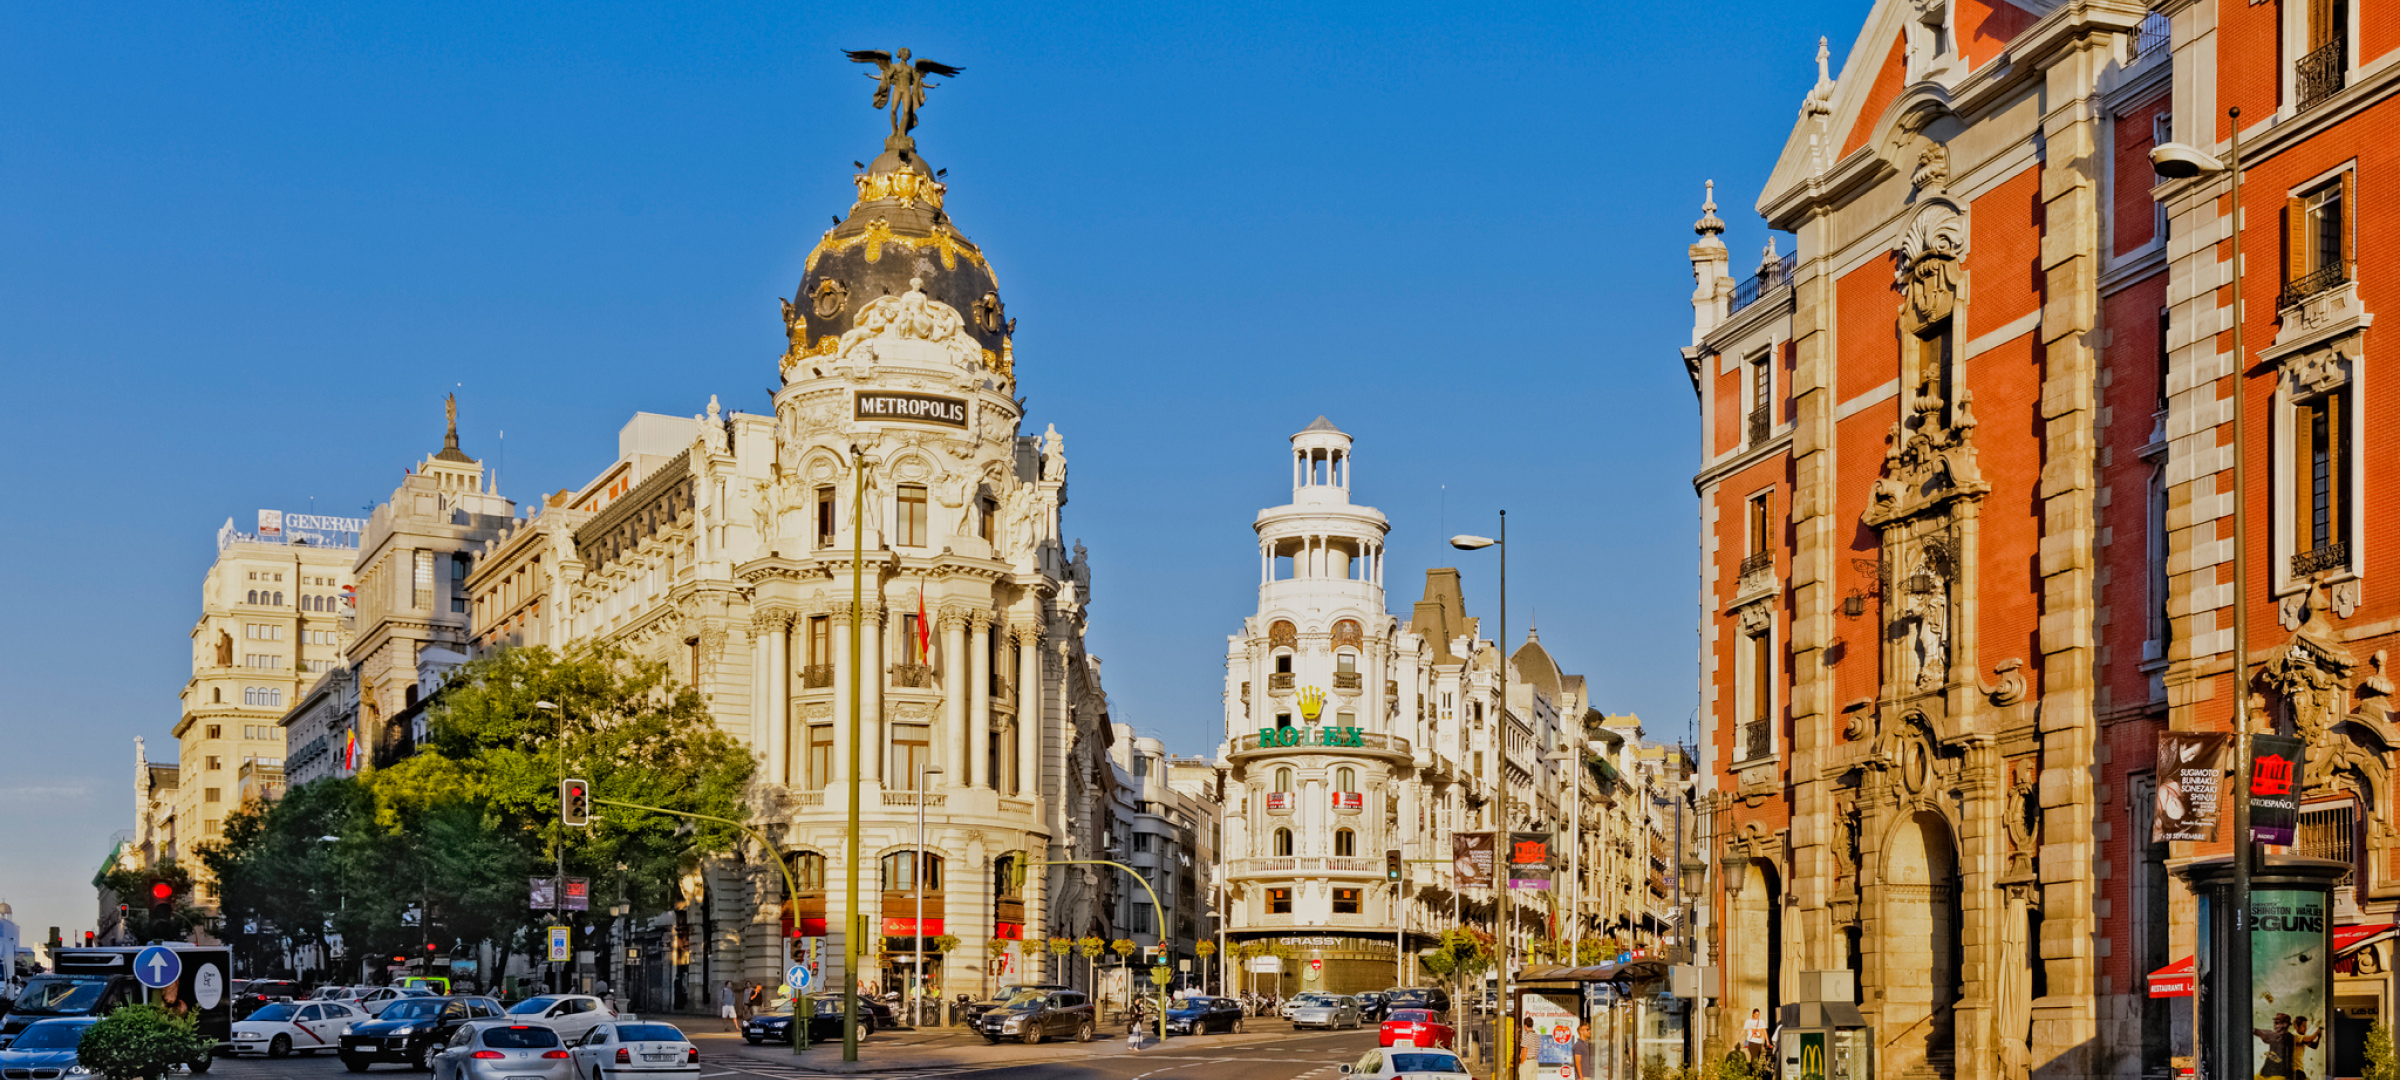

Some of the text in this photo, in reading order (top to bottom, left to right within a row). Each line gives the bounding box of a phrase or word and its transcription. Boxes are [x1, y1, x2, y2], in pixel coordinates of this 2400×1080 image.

[861, 398, 963, 421] METROPOLIS
[1259, 726, 1364, 747] ROLEX
[2180, 769, 2219, 777] SUGIMOTO
[2181, 785, 2217, 793] SONEZAKI
[2190, 793, 2216, 801] SHINJU
[2251, 907, 2291, 915] SHINGTON
[1281, 938, 1344, 946] GRASSY
[2150, 983, 2183, 992] RESTAURANTE
